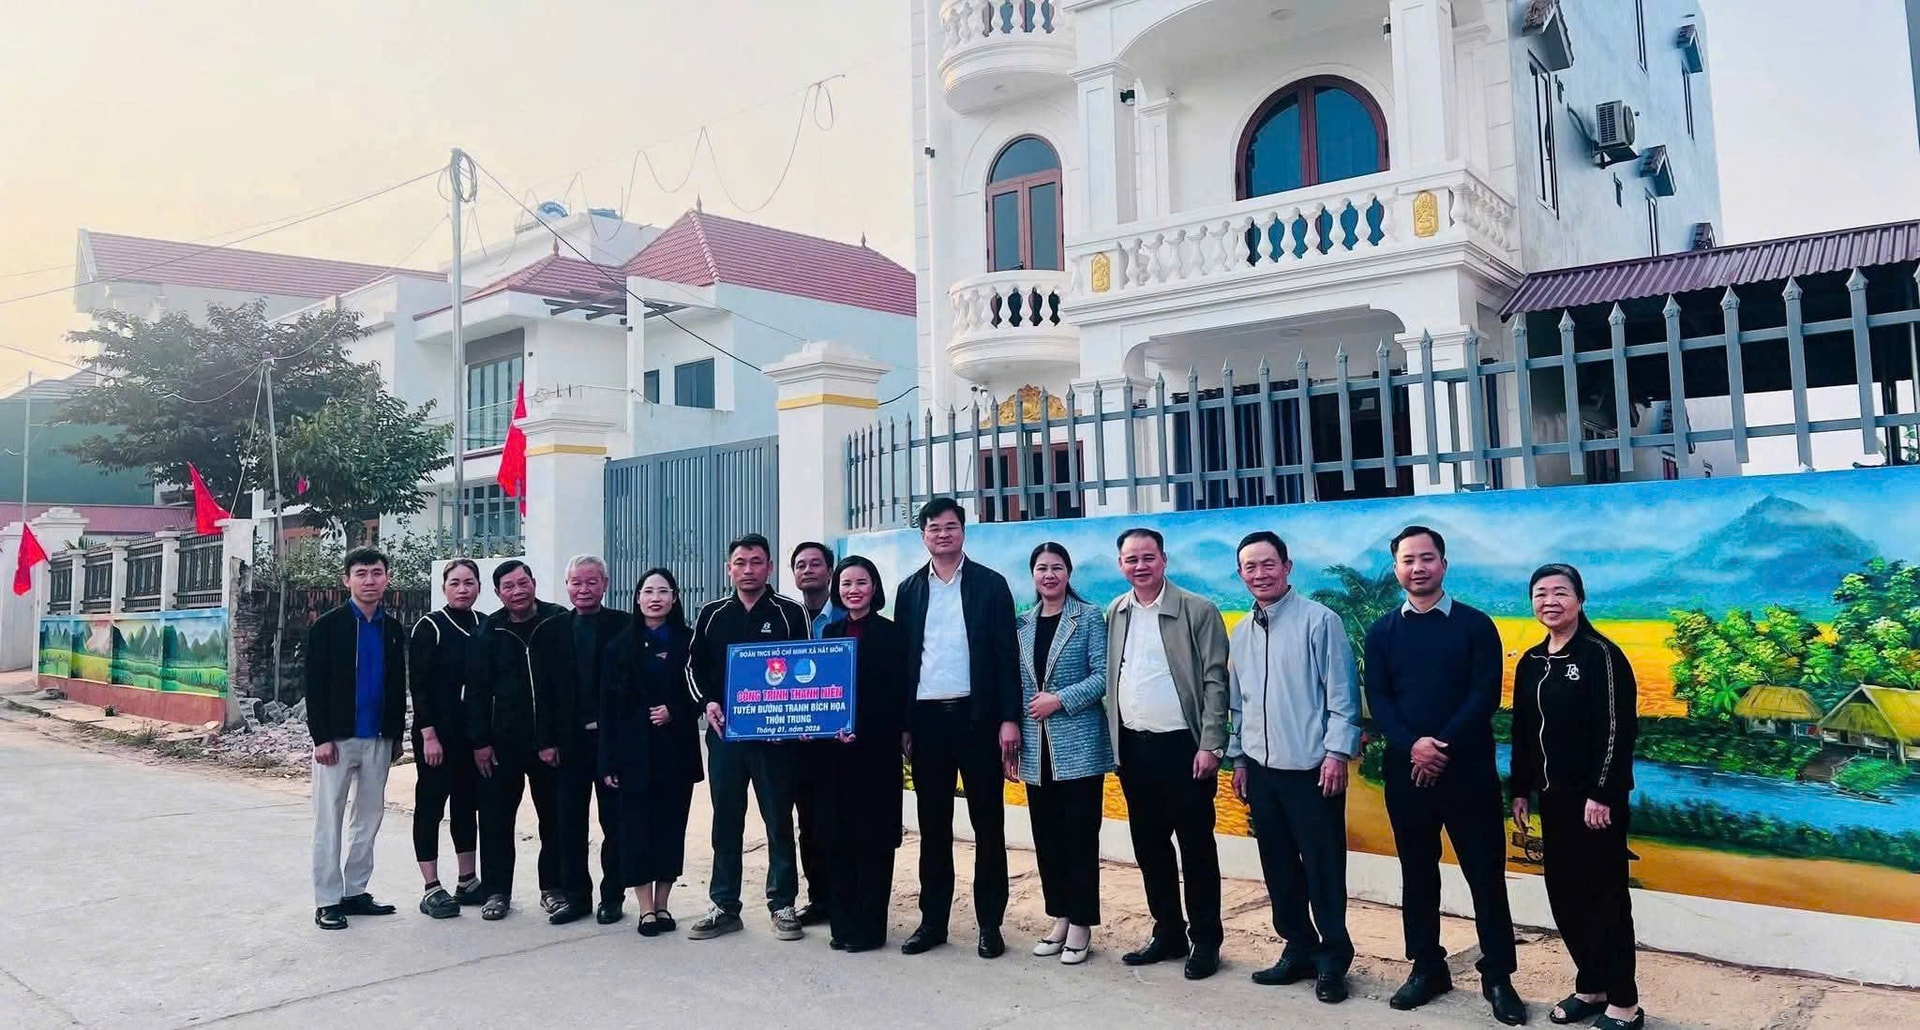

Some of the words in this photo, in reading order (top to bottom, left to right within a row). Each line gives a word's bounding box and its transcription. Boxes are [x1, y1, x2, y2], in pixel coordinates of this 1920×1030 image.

[772, 648, 780, 656] HỒ
[737, 688, 761, 703] CÔNG
[762, 687, 789, 701] TRÌNH
[790, 687, 819, 700] THANH
[820, 684, 843, 699] NIÊN
[785, 703, 809, 712] TRANH
[810, 702, 829, 711] BÍCH
[830, 702, 846, 712] HỌA
[765, 714, 785, 724] THÔN
[786, 714, 811, 723] TRUNG
[756, 726, 776, 734] Tháng
